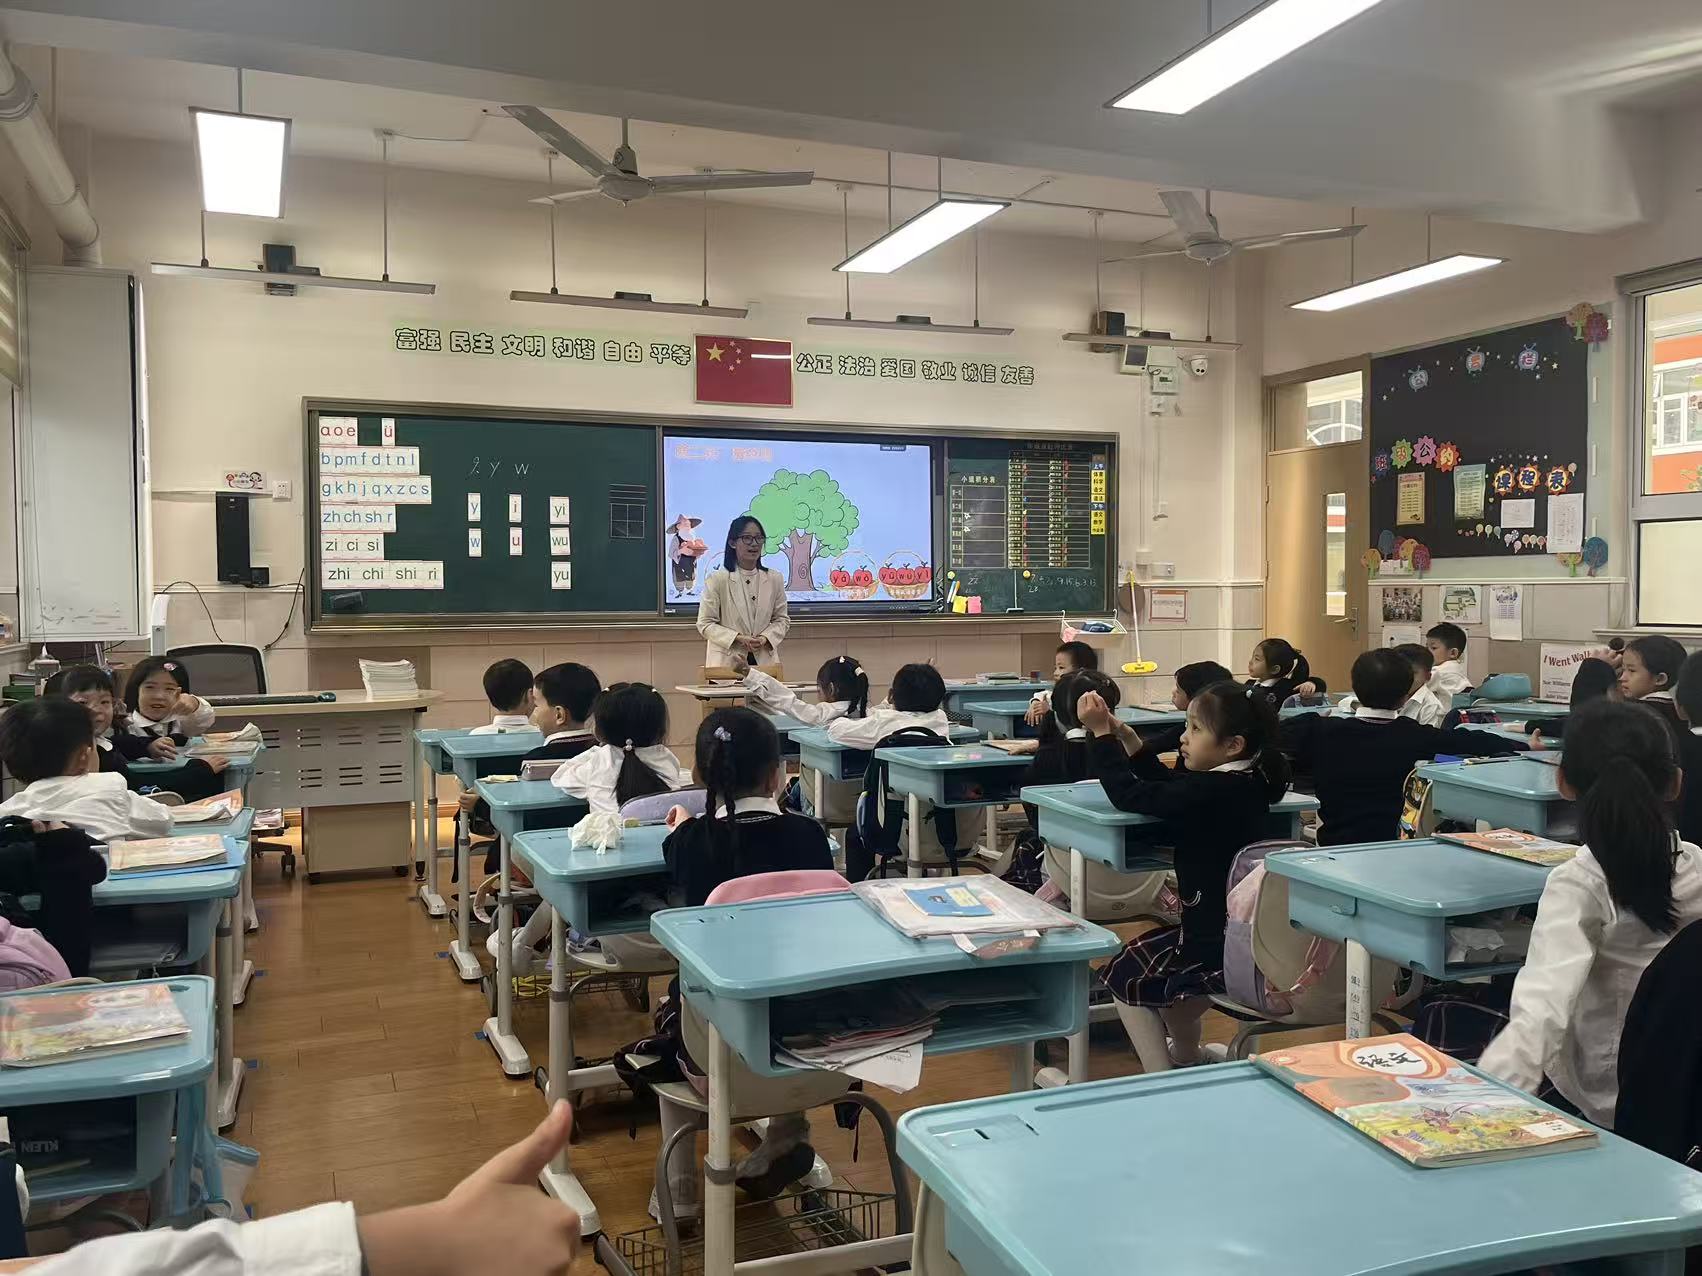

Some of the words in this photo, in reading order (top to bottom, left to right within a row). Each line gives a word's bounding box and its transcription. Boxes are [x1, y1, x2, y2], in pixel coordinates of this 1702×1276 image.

[395, 328, 441, 351] 富强
[450, 331, 494, 355] 民主
[502, 335, 545, 358] 文明
[553, 337, 595, 360] 和谐
[604, 341, 642, 362] 自由
[650, 344, 691, 366] 平等
[796, 353, 833, 374] 公正
[839, 356, 875, 376] 法治
[881, 358, 915, 378] 爱国
[922, 360, 956, 380] 敬业
[962, 362, 996, 383] 诚信
[1001, 365, 1034, 385] 友善
[385, 425, 393, 438] ü
[1496, 470, 1564, 490] 课程表
[323, 510, 341, 523] zh
[344, 510, 361, 523] ch
[365, 510, 382, 523] sh
[471, 502, 480, 515] y
[555, 504, 566, 519] yi
[325, 538, 338, 551] zi
[346, 538, 359, 551] ci
[367, 538, 380, 551] si
[471, 537, 482, 547] w
[513, 536, 521, 546] u
[553, 537, 570, 546] wu
[328, 567, 350, 580] zhi
[362, 567, 384, 580] chi
[395, 567, 417, 580] shi
[428, 567, 437, 580] ri
[554, 571, 569, 584] yu
[1543, 655, 1548, 663] I
[1549, 655, 1571, 667] Went
[1357, 1052, 1422, 1069] 语文
